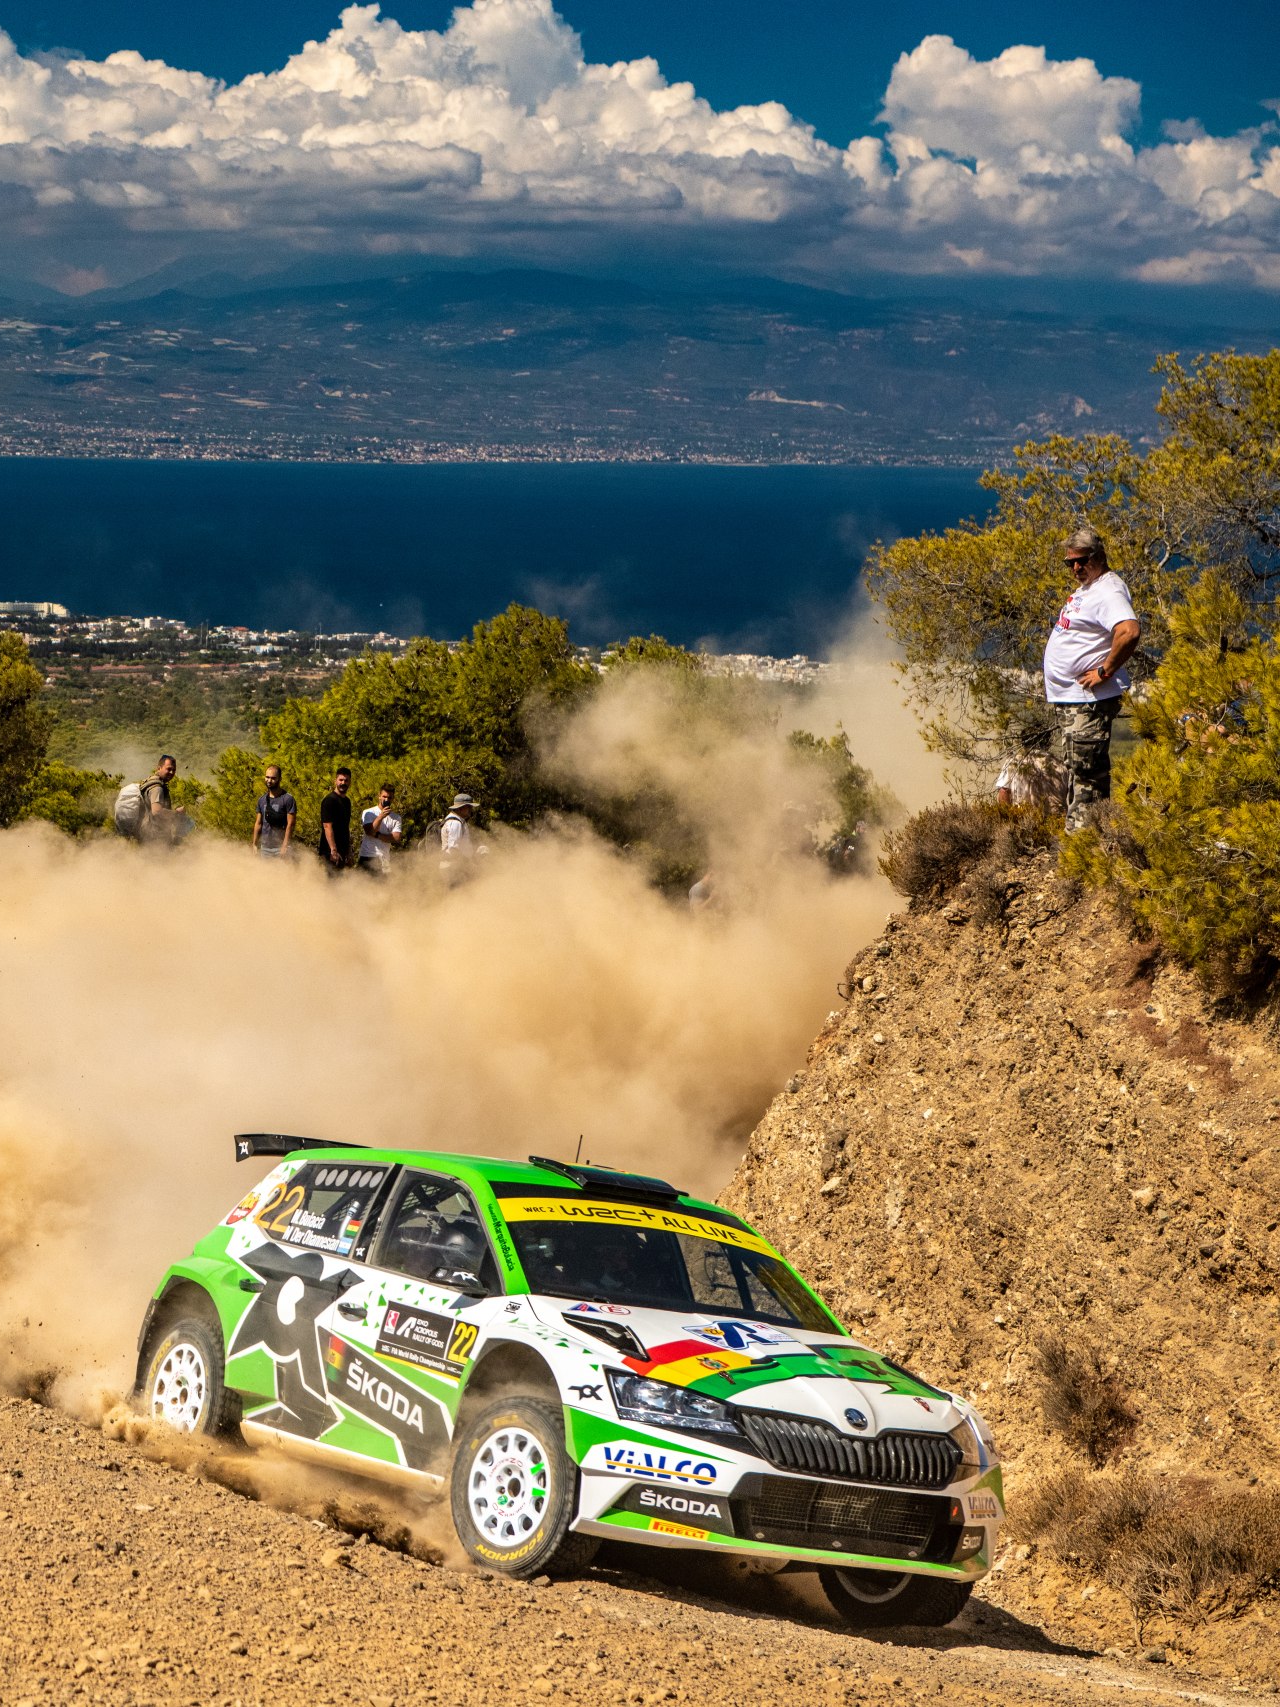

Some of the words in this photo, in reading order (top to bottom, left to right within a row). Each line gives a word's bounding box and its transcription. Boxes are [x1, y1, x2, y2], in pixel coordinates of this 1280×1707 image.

[253, 1182, 305, 1233] 22
[662, 1216, 698, 1232] ALL
[699, 1223, 742, 1243] LIVE
[448, 1322, 477, 1365] 22
[346, 1358, 424, 1434] ŠKODA
[639, 1489, 722, 1518] ŠKODA
[474, 1527, 545, 1561] SCORPION
[652, 1521, 705, 1539] PIRELLI
